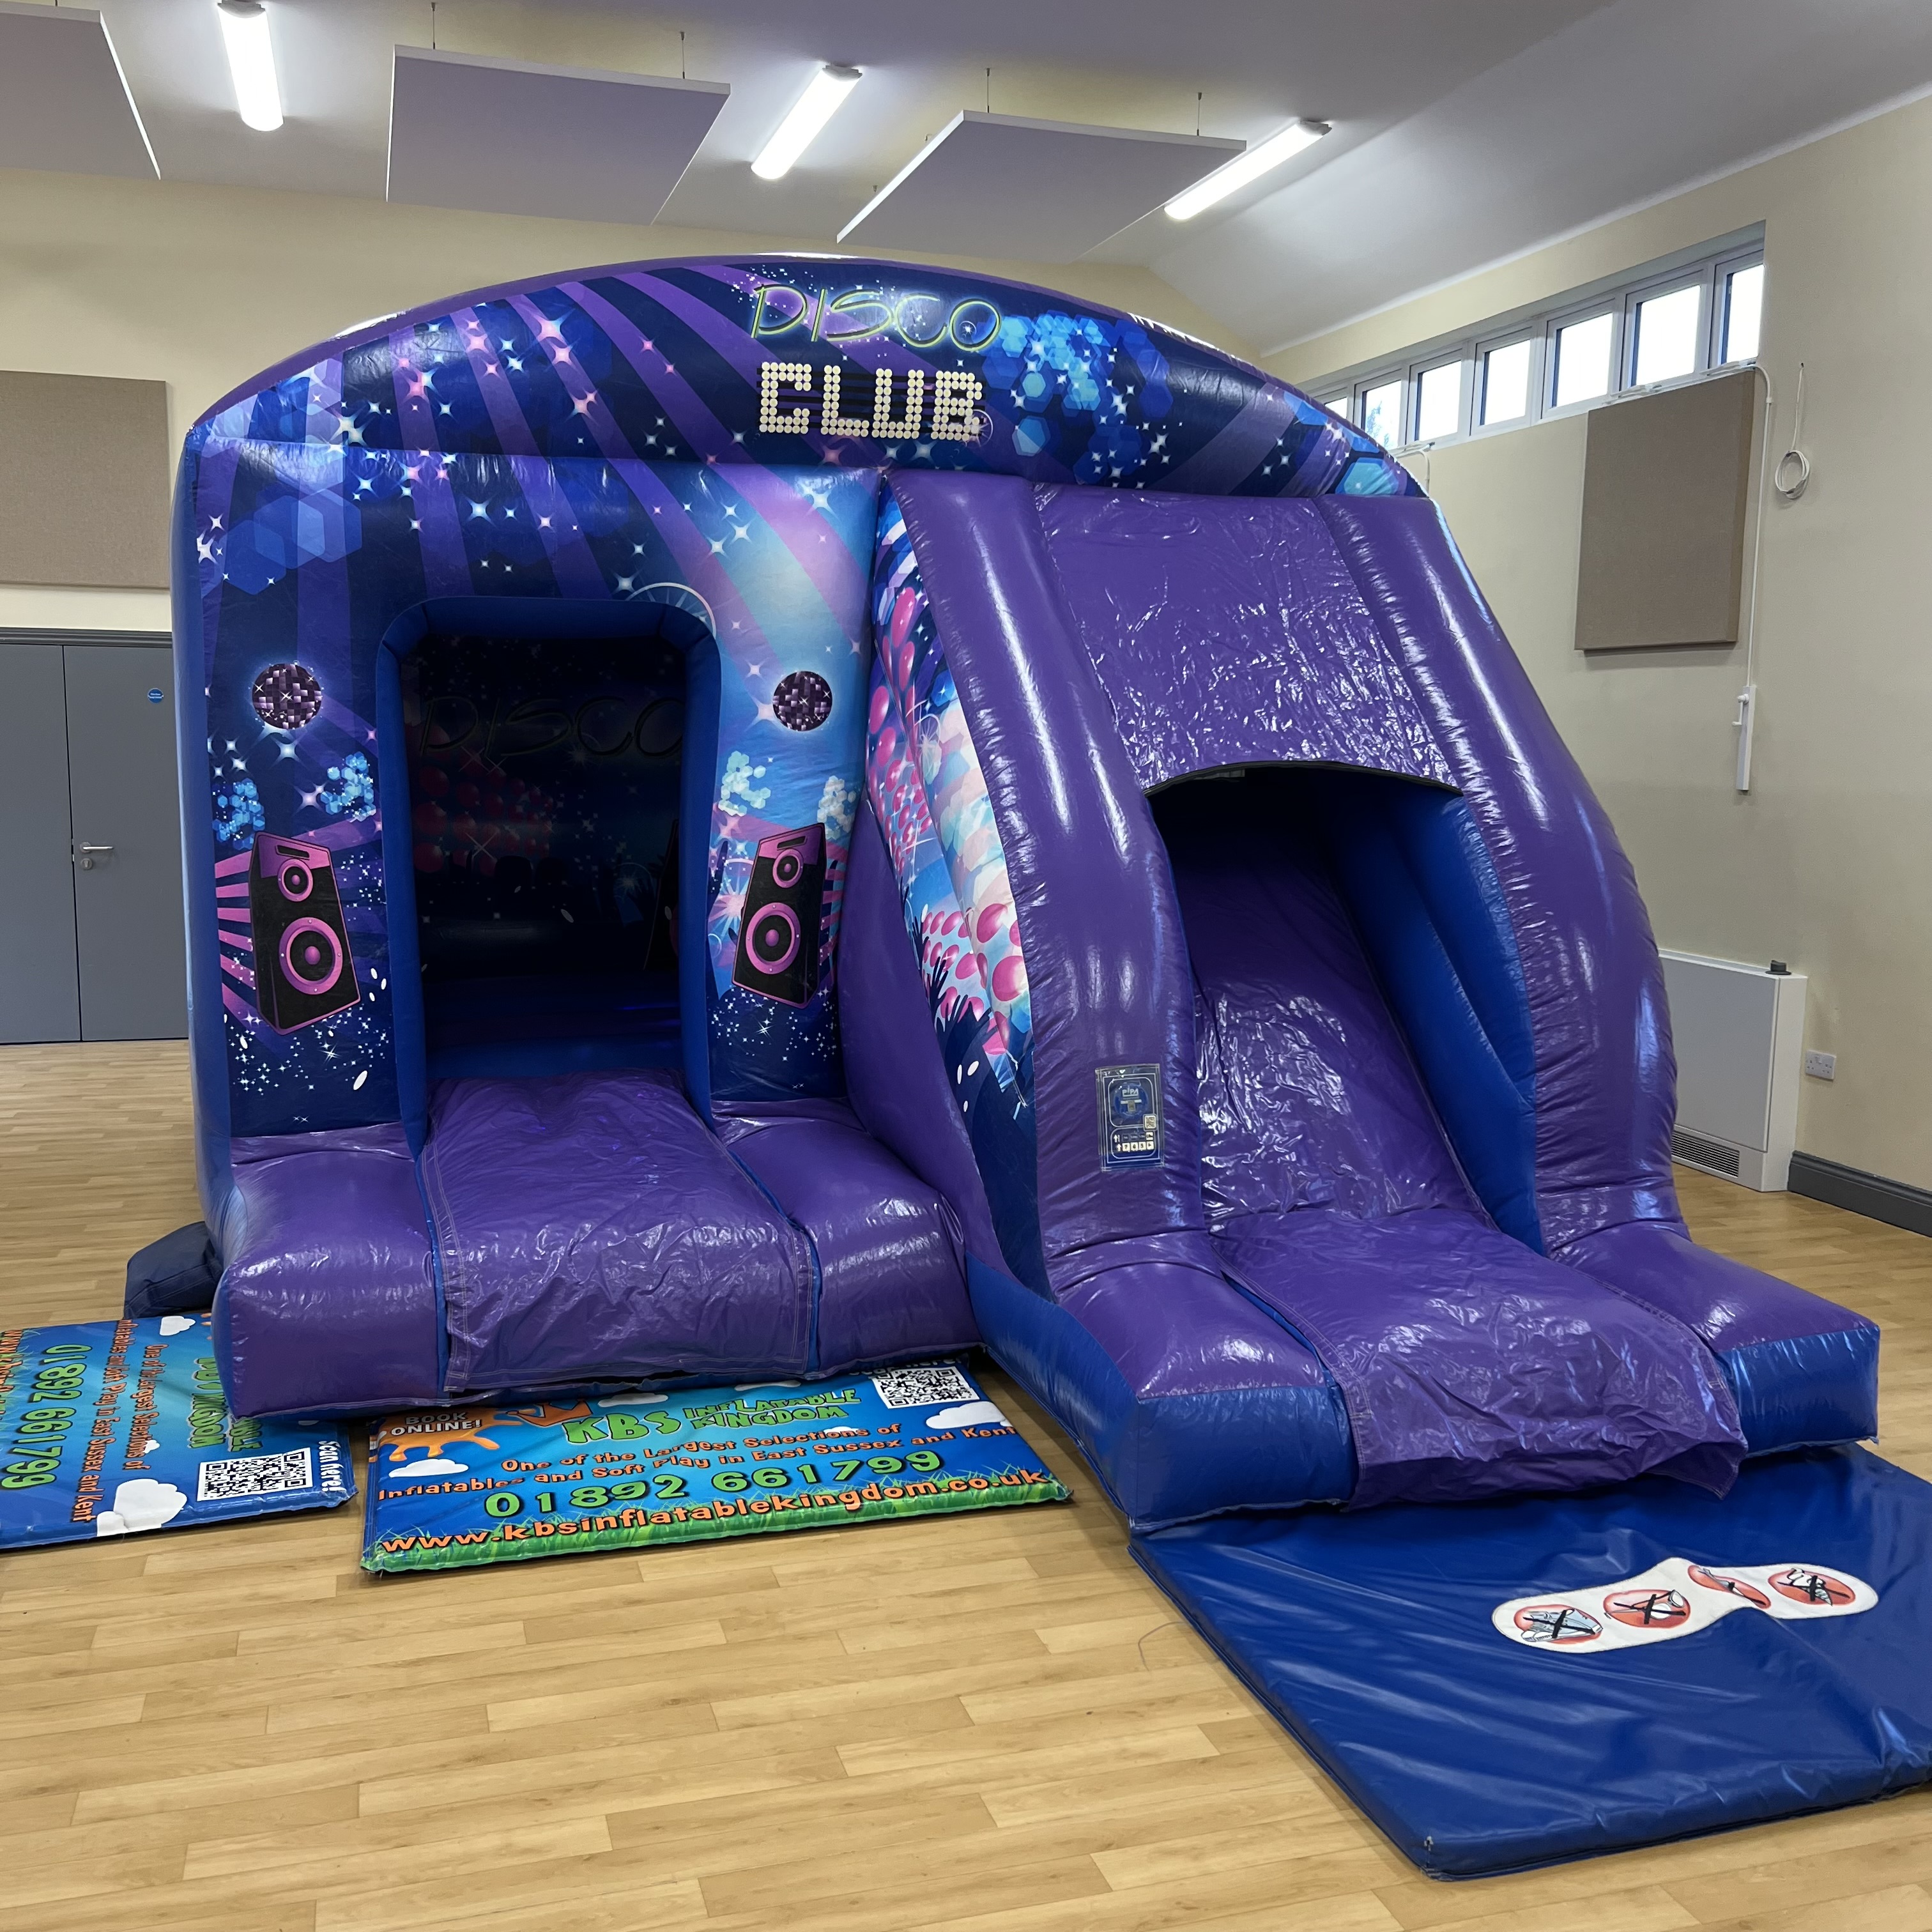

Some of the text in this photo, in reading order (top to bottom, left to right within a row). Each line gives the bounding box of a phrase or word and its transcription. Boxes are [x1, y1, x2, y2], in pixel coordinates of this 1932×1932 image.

[751, 284, 1002, 353] DISCO
[759, 362, 983, 441] CLUB
[419, 695, 686, 758] DISCO
[109, 1319, 139, 1353] nflatables
[144, 1344, 169, 1358] One
[93, 1382, 127, 1405] Play
[130, 1379, 163, 1411] Largest
[682, 1389, 861, 1419] INFLATABLE
[1, 1344, 93, 1489] 01892 661799
[91, 1417, 121, 1436] East
[96, 1407, 121, 1416] in
[188, 1392, 228, 1448] KINGDOM
[391, 1420, 482, 1436] ONLINE!
[405, 1412, 467, 1425] BOOK
[562, 1410, 681, 1444] KBS
[691, 1405, 848, 1429] KINGDOM
[125, 1412, 159, 1458] Selections
[502, 1423, 901, 1472] One of the Largest Selections of
[82, 1438, 116, 1472] Sussex
[123, 1460, 151, 1470] of
[379, 1426, 1018, 1501] Inflatables and Soft Play in East Sussex and Kent
[77, 1475, 105, 1492] and
[320, 1463, 346, 1492] here!
[485, 1450, 942, 1517] 01892 661799
[70, 1494, 104, 1522] Kent
[381, 1469, 1052, 1553] www.kbsinflatablekingdom.co.uk
